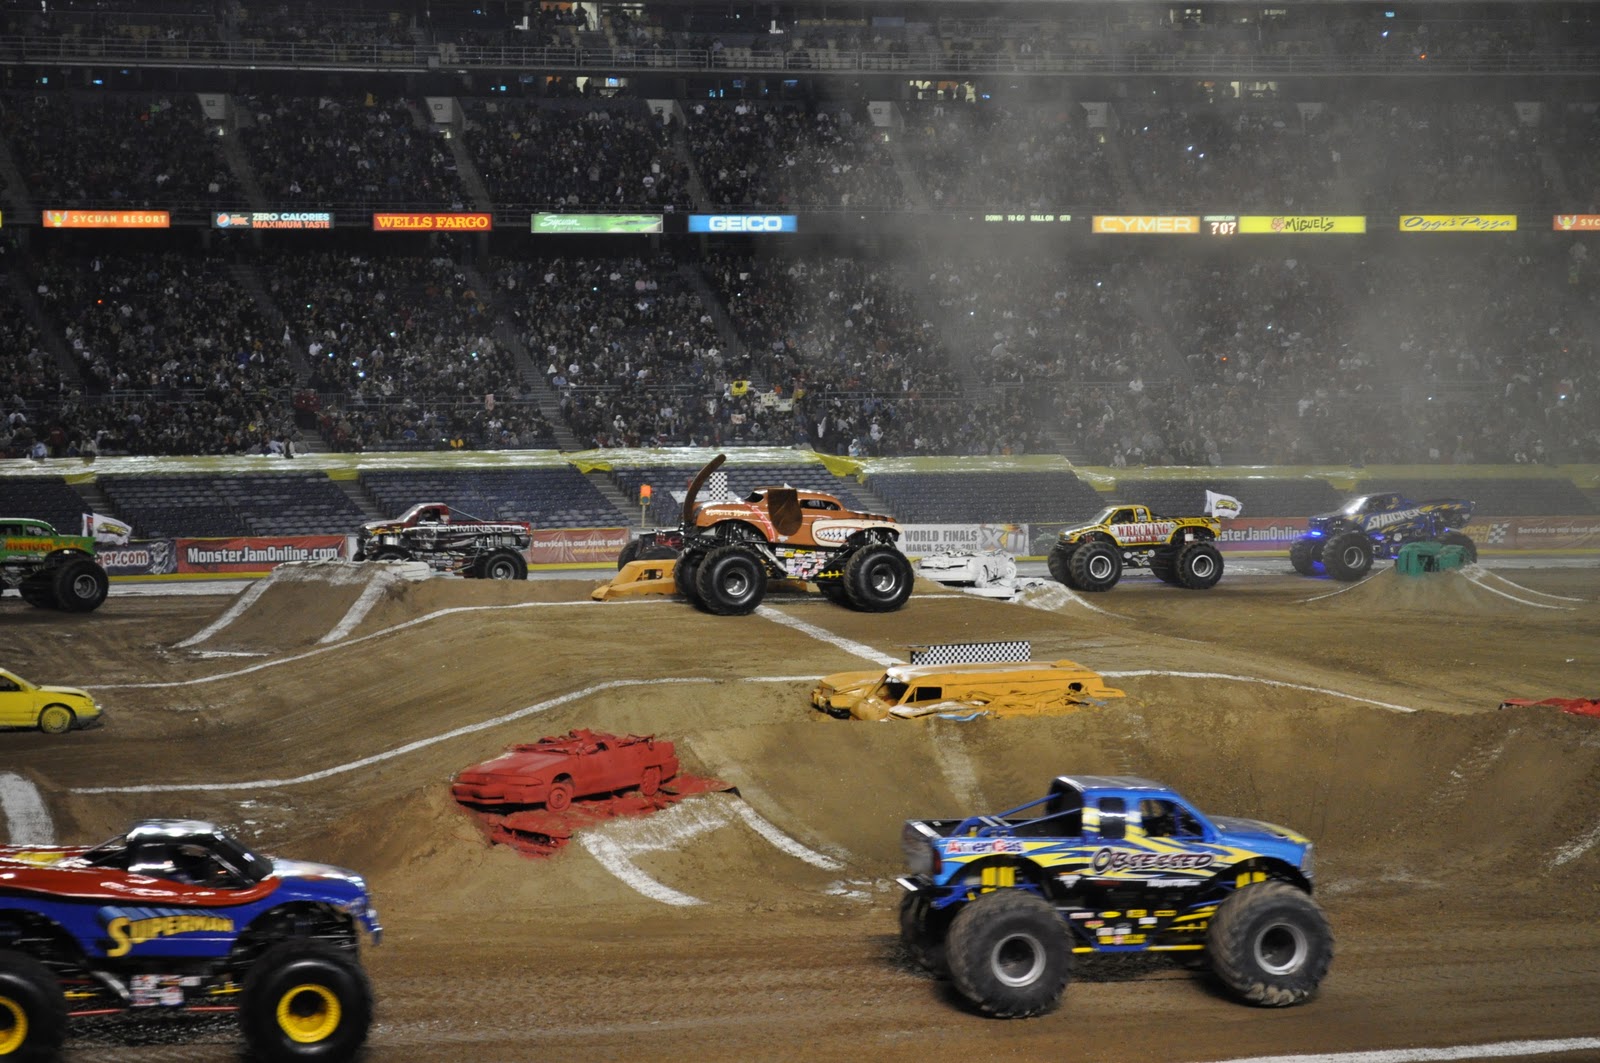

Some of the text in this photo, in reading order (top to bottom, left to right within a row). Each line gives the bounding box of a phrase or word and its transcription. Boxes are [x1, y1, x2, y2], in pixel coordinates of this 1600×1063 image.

[72, 215, 166, 223] SYCUAN RESORT
[252, 212, 330, 221] ZERO CALORIES
[377, 216, 489, 228] WELLS FARGO
[709, 216, 782, 231] GEICO
[1404, 216, 1511, 230] Oggi's Pizza
[252, 220, 330, 228] MAXIMUM TASTE
[1101, 217, 1191, 231] CYMER
[1364, 508, 1420, 531] SHOCKER
[428, 524, 523, 534] TERMINATOR
[904, 530, 978, 542] WORLD FINALS
[1117, 523, 1169, 537] WRECKING
[1214, 527, 1307, 541] sterJamOnlin
[534, 540, 563, 548] Service
[905, 544, 932, 552] MARCH
[187, 547, 339, 563] MonsterJamOnline.com
[1092, 846, 1214, 875] OBSESSED
[107, 915, 234, 957] SUPERMAN
